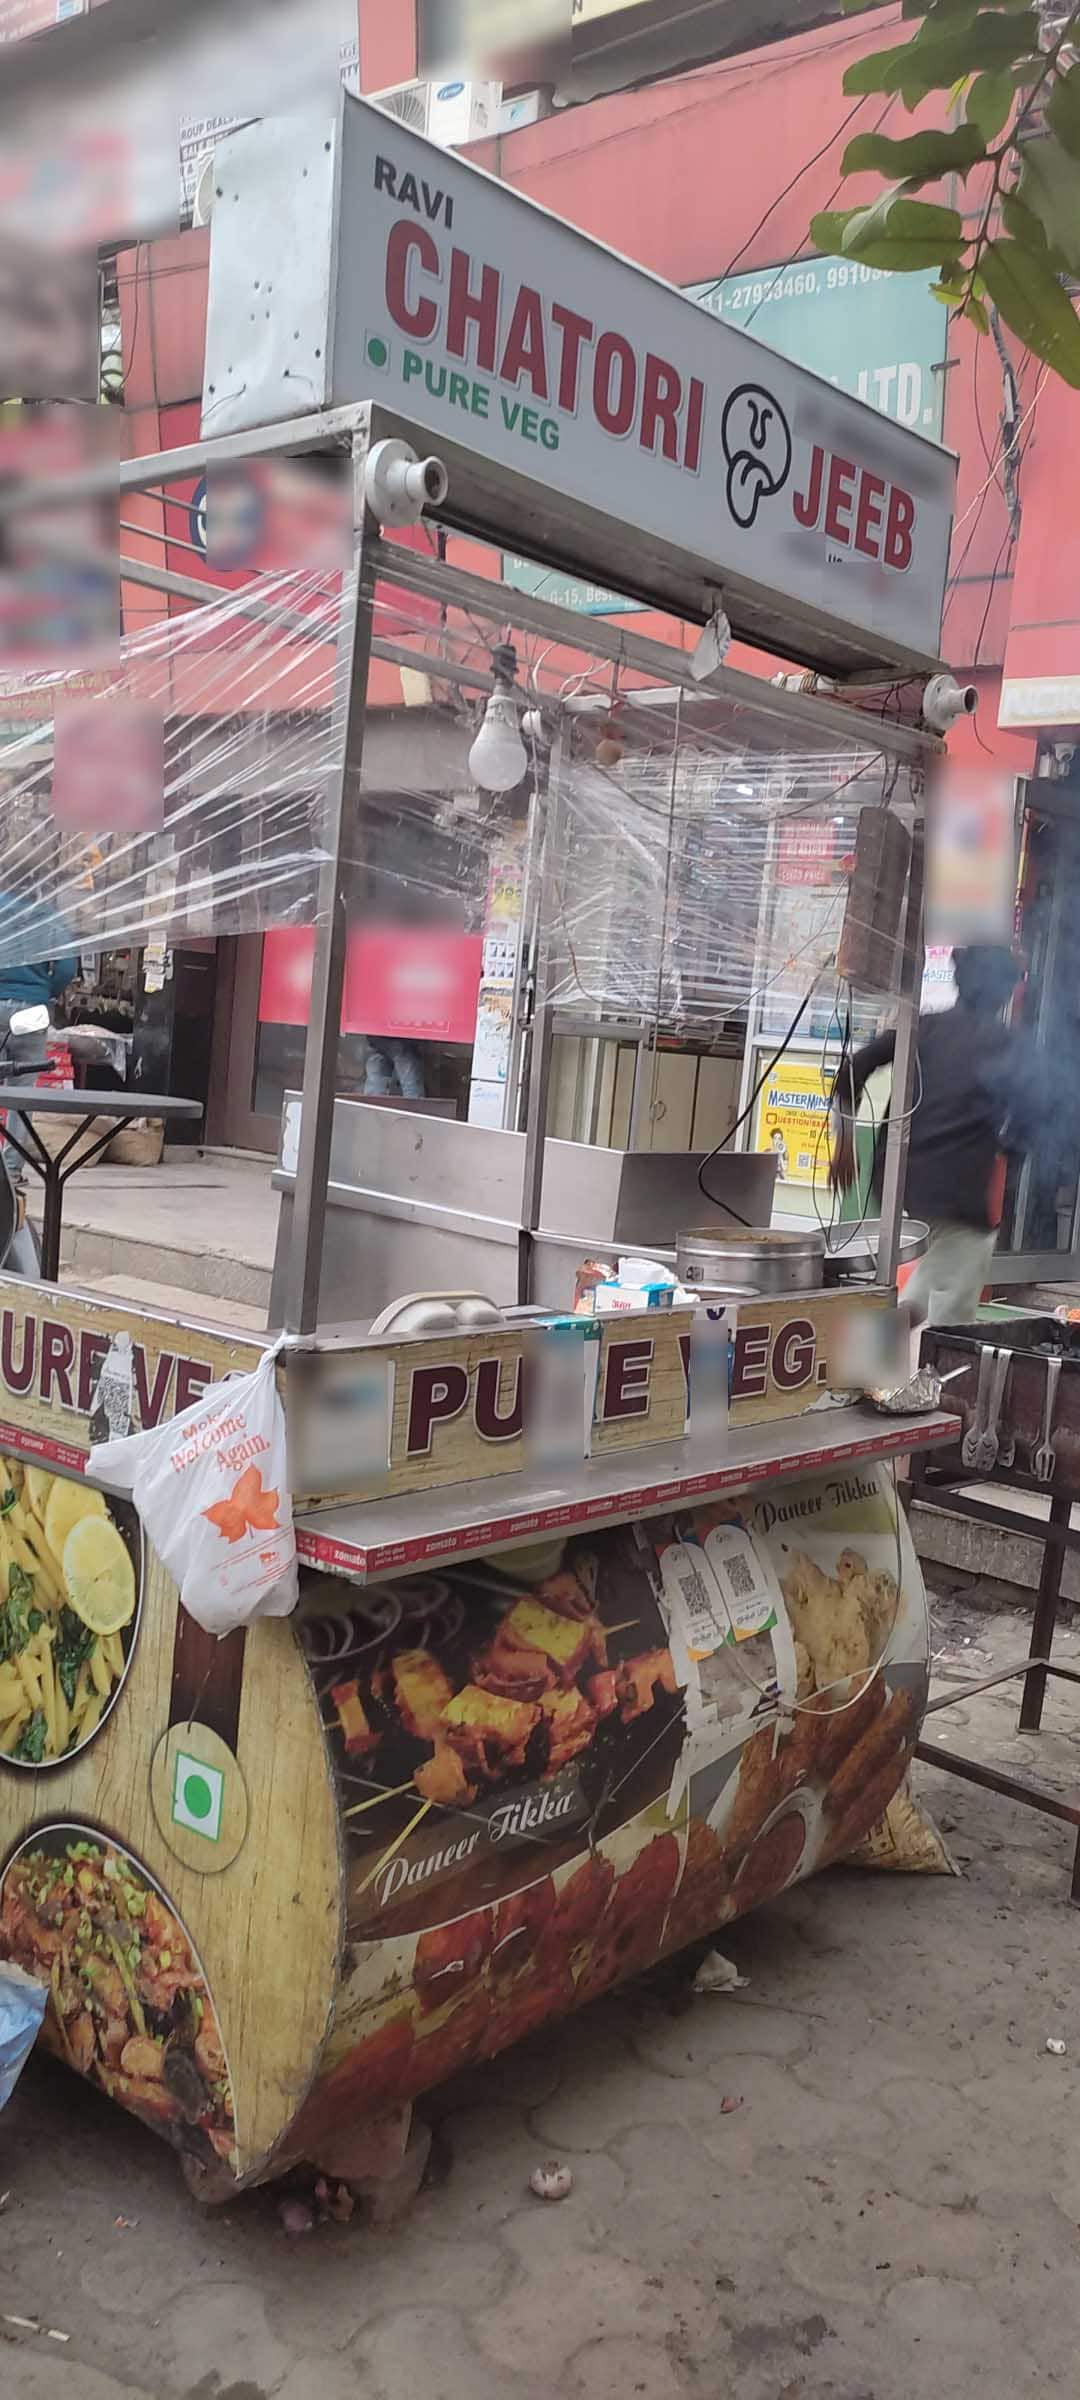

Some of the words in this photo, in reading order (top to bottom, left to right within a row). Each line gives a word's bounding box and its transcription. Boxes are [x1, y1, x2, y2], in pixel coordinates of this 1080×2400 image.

[373, 155, 456, 229] RAVI
[384, 217, 704, 474] CHATORI
[402, 351, 490, 420] PURE
[500, 395, 560, 451] VEG
[791, 444, 917, 573] JEEB
[406, 1338, 654, 1456] PUE
[333, 1549, 366, 1567] zomato
[754, 1496, 823, 1534] Paneer
[825, 1476, 879, 1507] Tikka
[374, 1830, 480, 1907] Paneer
[488, 1791, 575, 1843] Tikka
